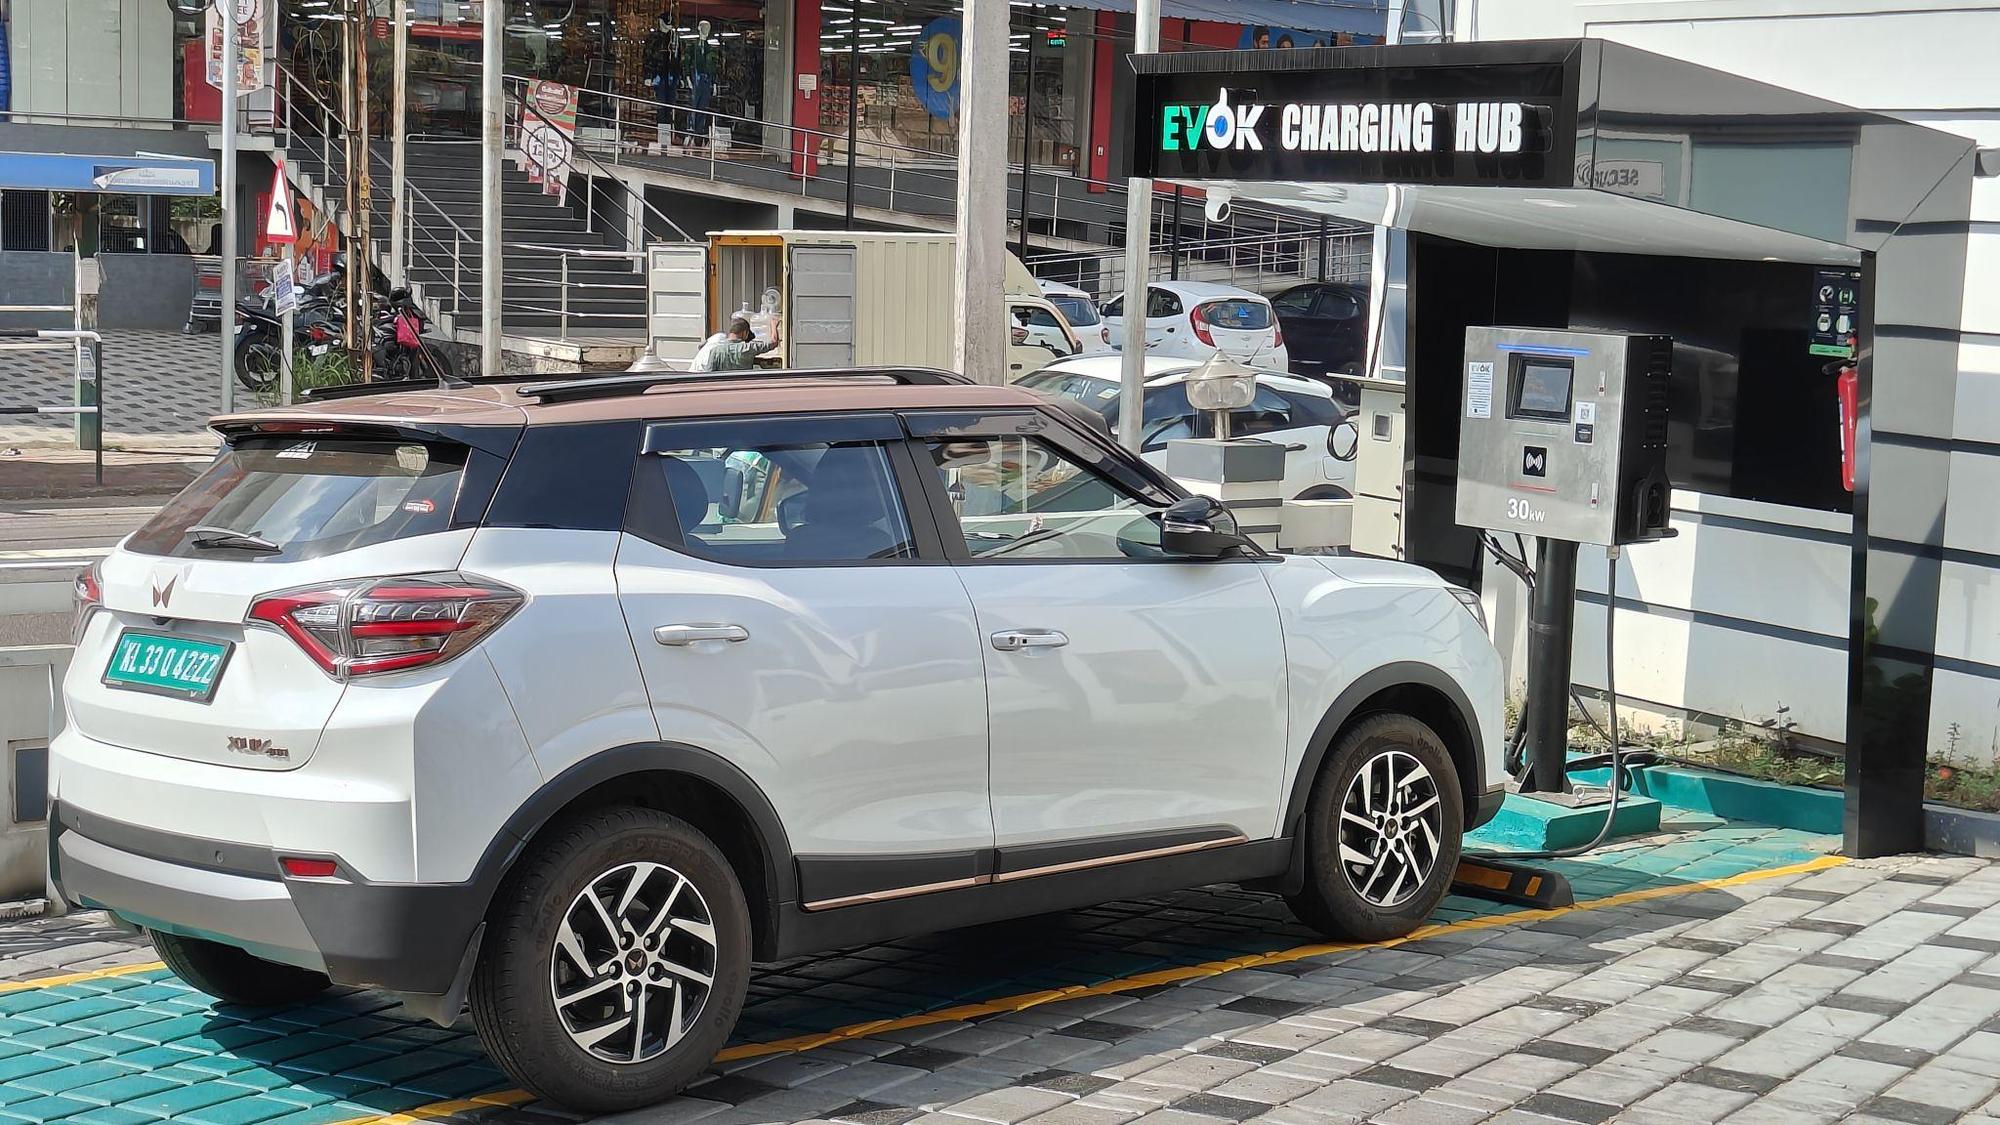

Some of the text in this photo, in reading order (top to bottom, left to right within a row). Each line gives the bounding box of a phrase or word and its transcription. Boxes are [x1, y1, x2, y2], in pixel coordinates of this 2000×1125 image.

[927, 33, 957, 93] 9
[1162, 87, 1522, 153] EVOK CHARGING HUB
